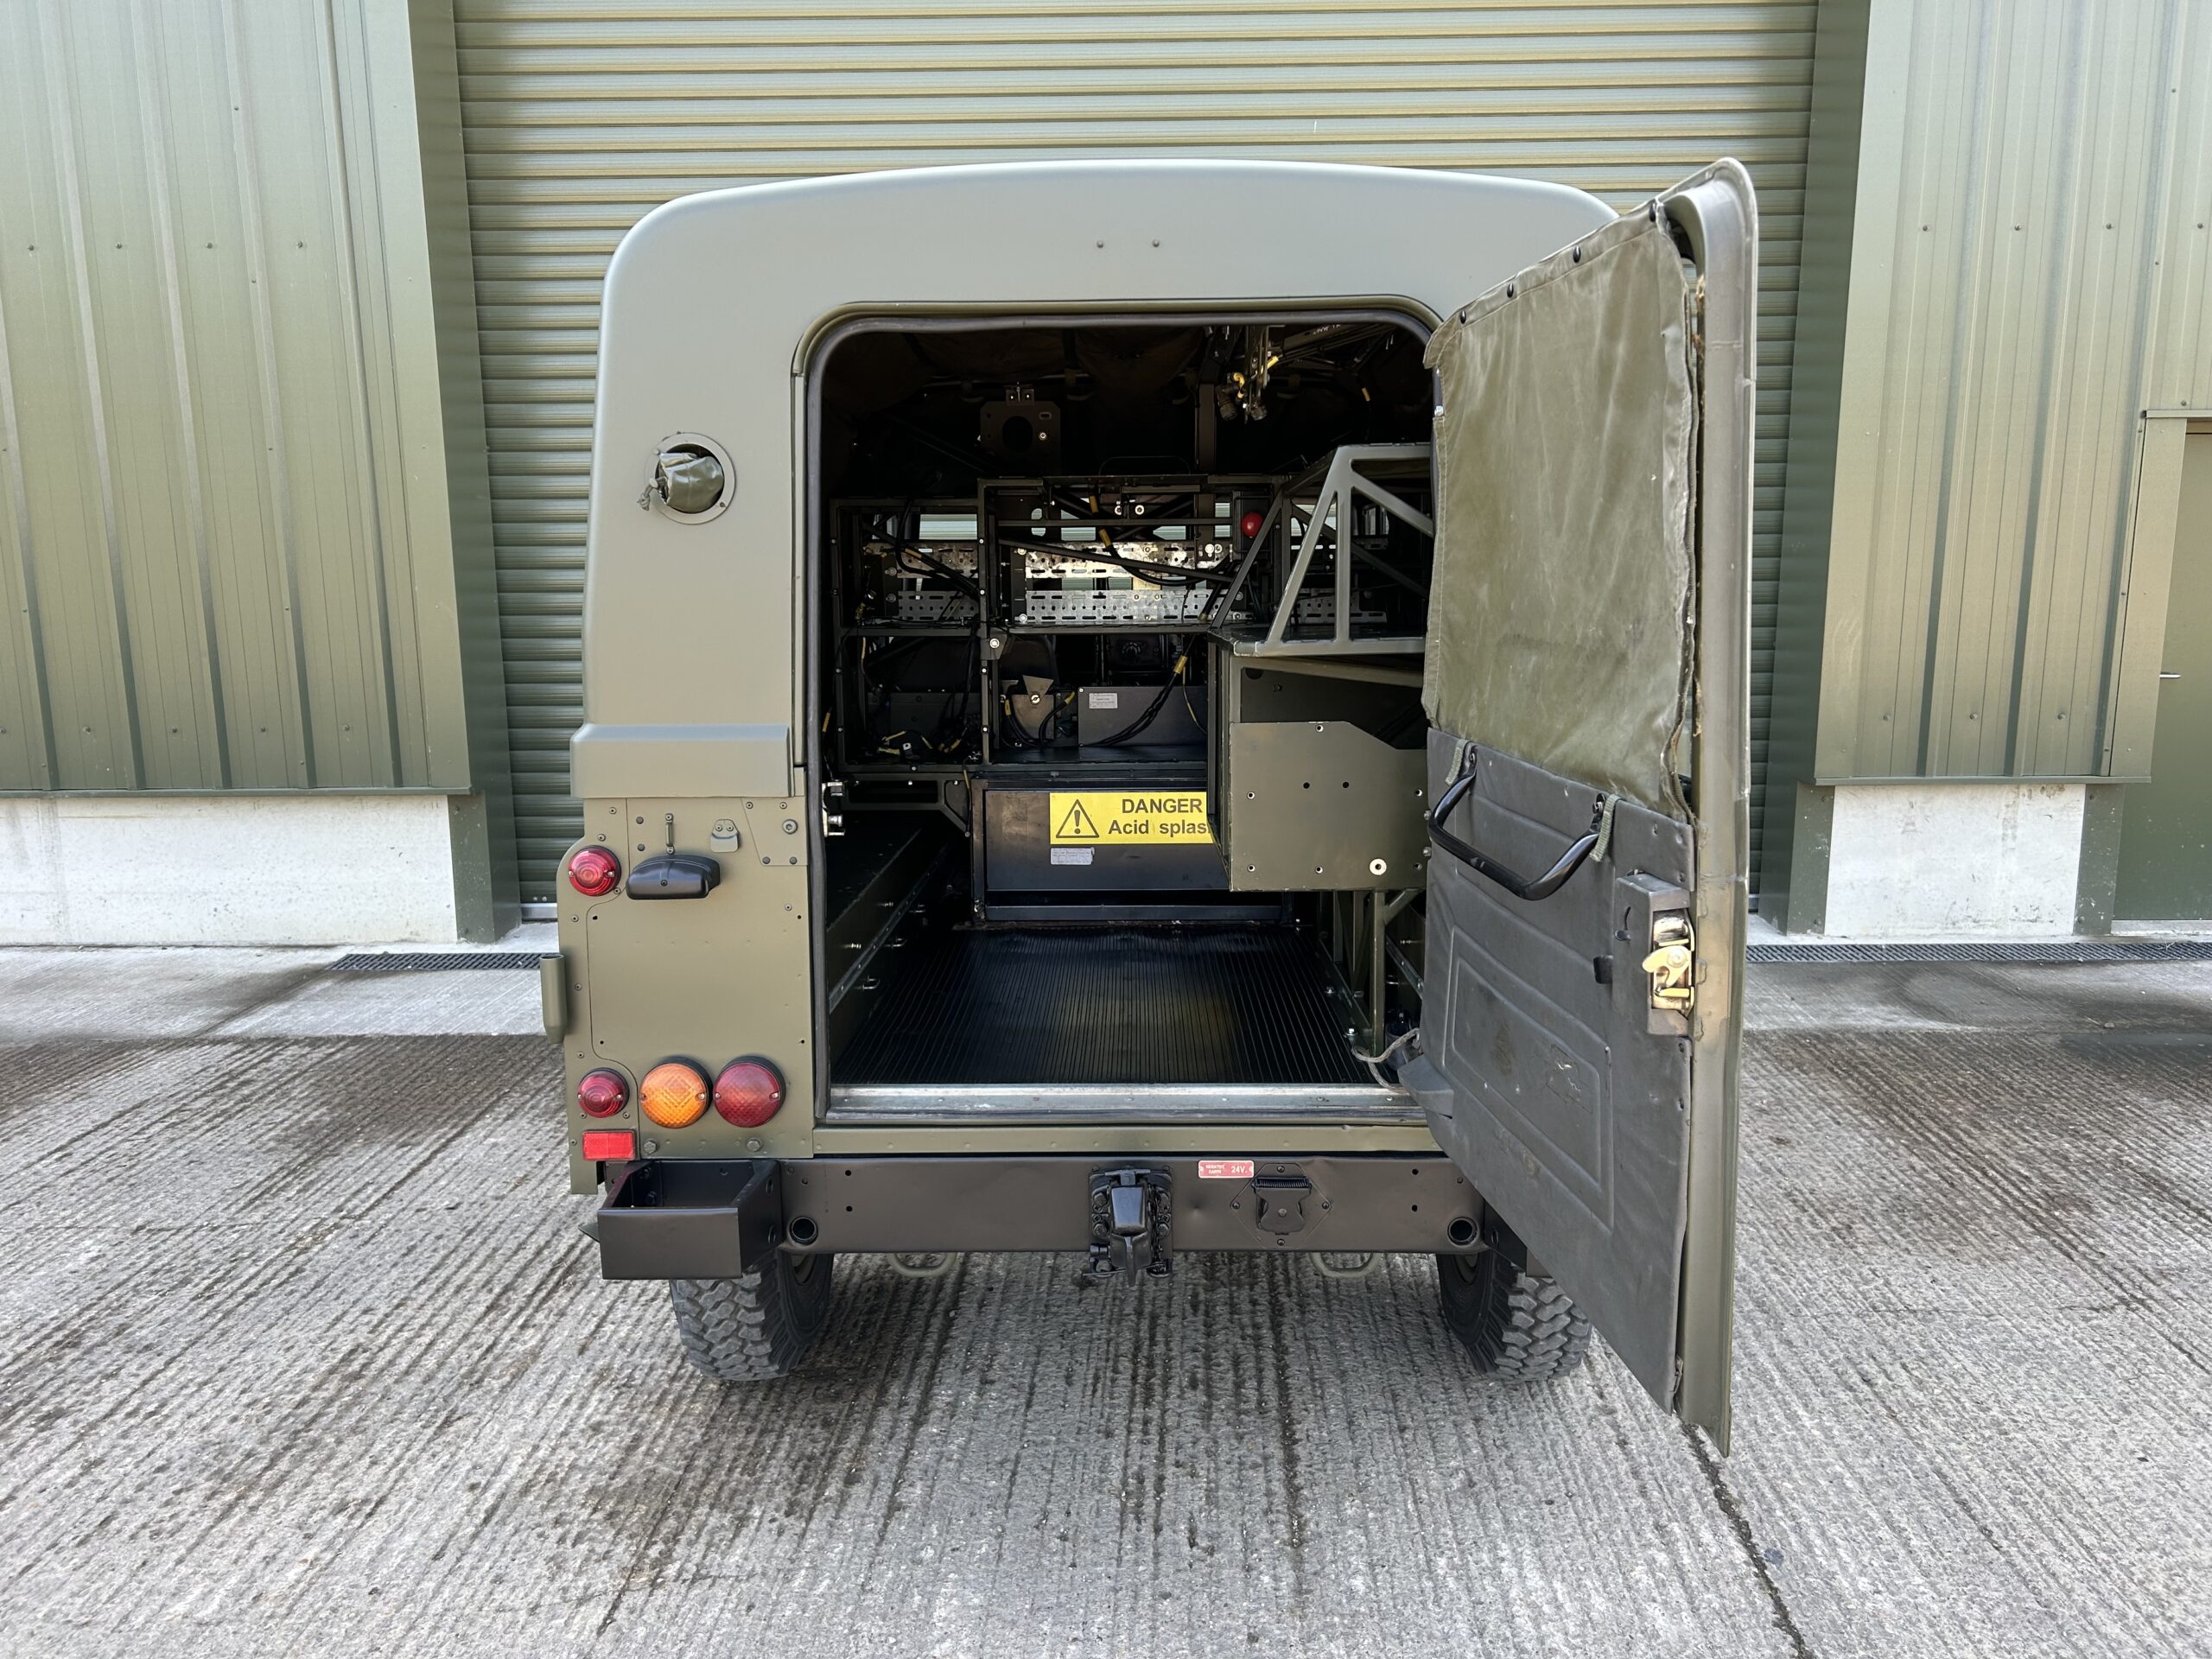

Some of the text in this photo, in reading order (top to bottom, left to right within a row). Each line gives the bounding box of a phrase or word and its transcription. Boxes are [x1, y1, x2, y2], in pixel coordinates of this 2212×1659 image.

[1122, 798, 1203, 814] DANGER
[1108, 819, 1211, 838] Acid splas
